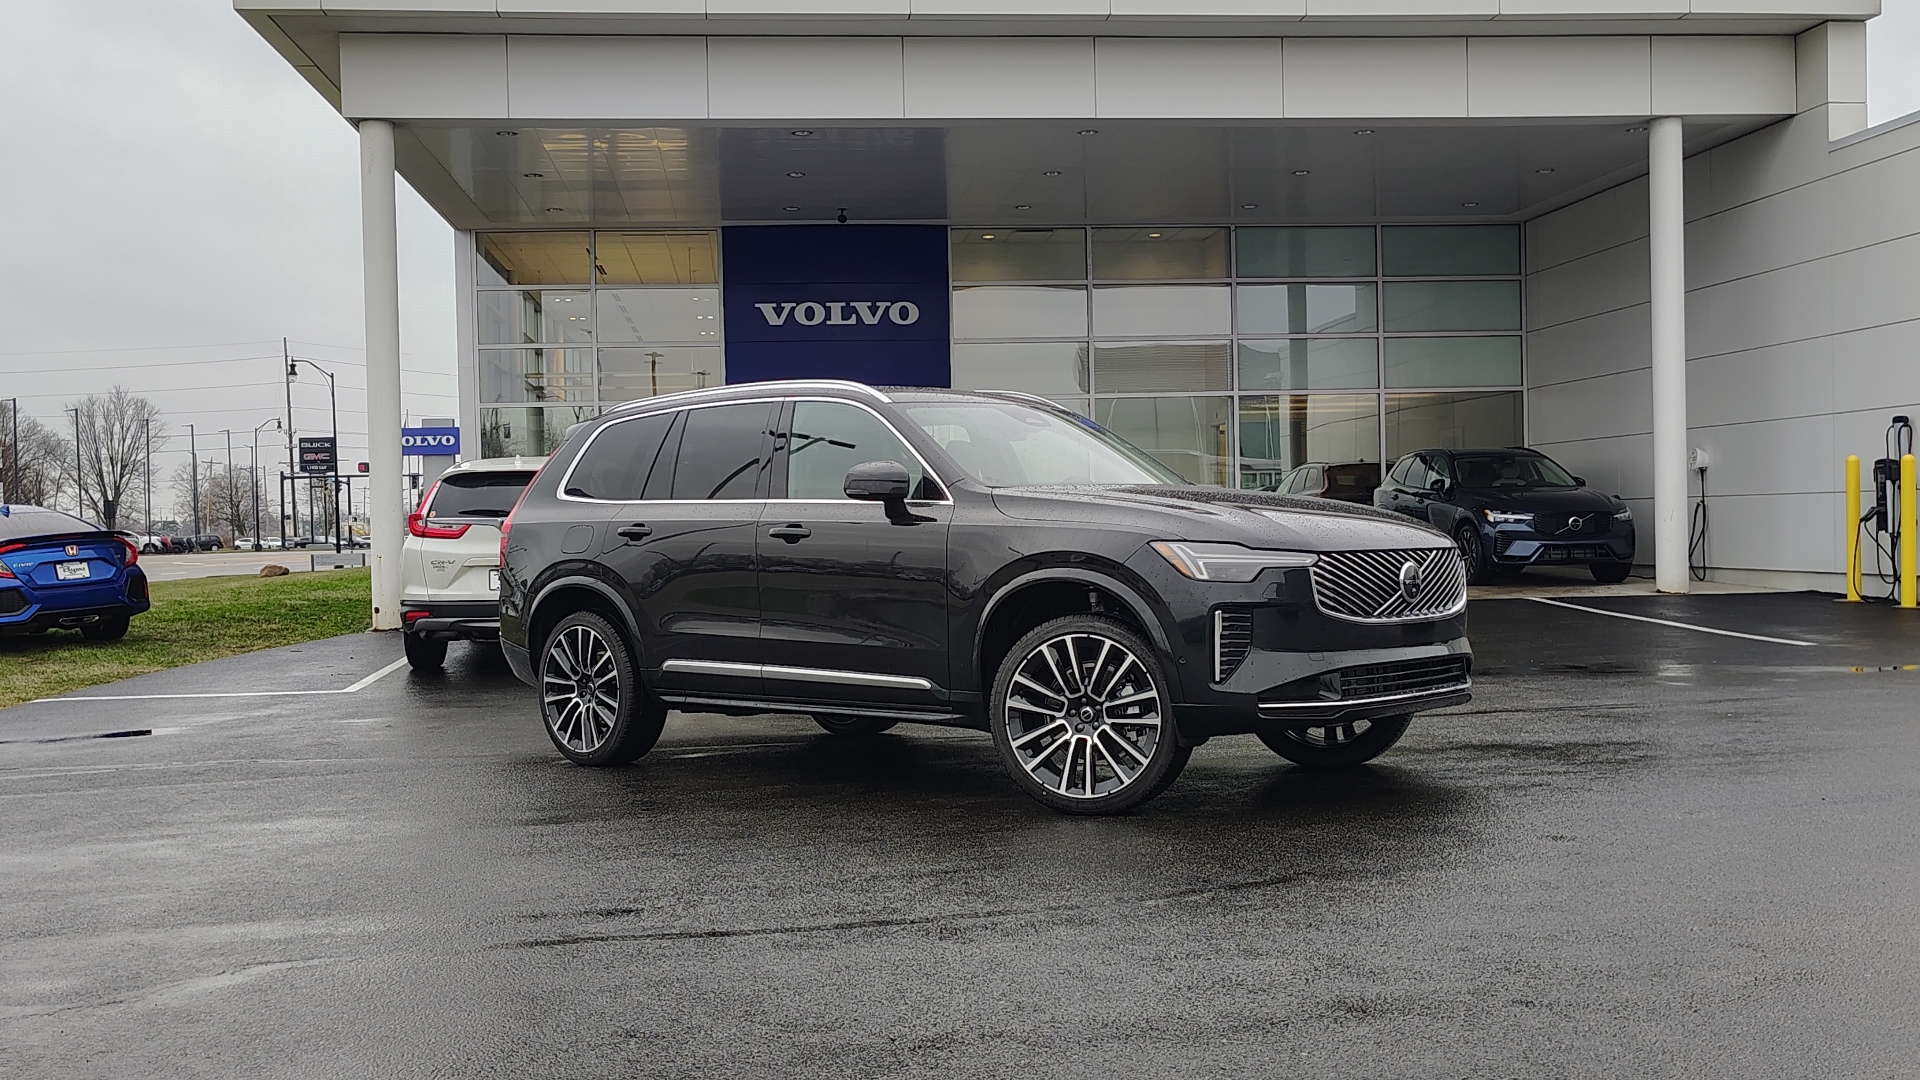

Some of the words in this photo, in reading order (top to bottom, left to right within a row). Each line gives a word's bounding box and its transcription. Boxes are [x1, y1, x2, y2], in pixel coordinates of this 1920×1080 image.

[754, 301, 920, 326] VOLVO
[402, 435, 455, 447] OLVO
[303, 452, 330, 460] GMC
